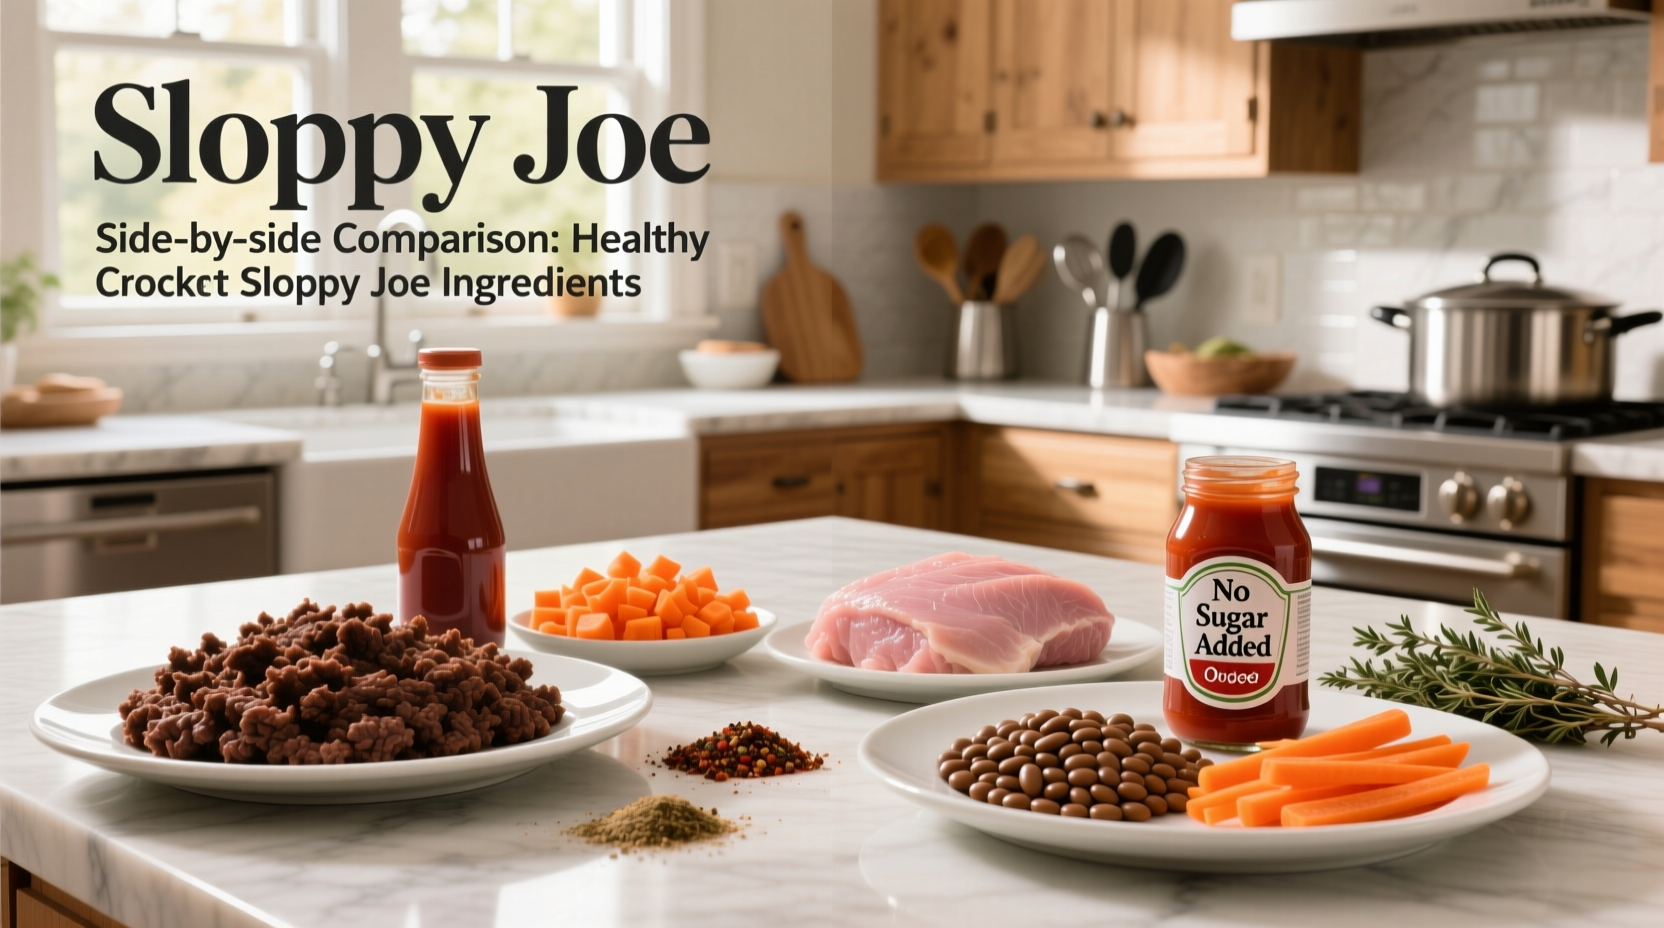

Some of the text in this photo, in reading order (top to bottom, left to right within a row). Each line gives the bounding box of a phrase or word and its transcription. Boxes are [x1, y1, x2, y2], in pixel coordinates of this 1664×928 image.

[1212, 578, 1250, 602] No
[1196, 602, 1269, 635] Sugar
[1194, 632, 1272, 657] Added
